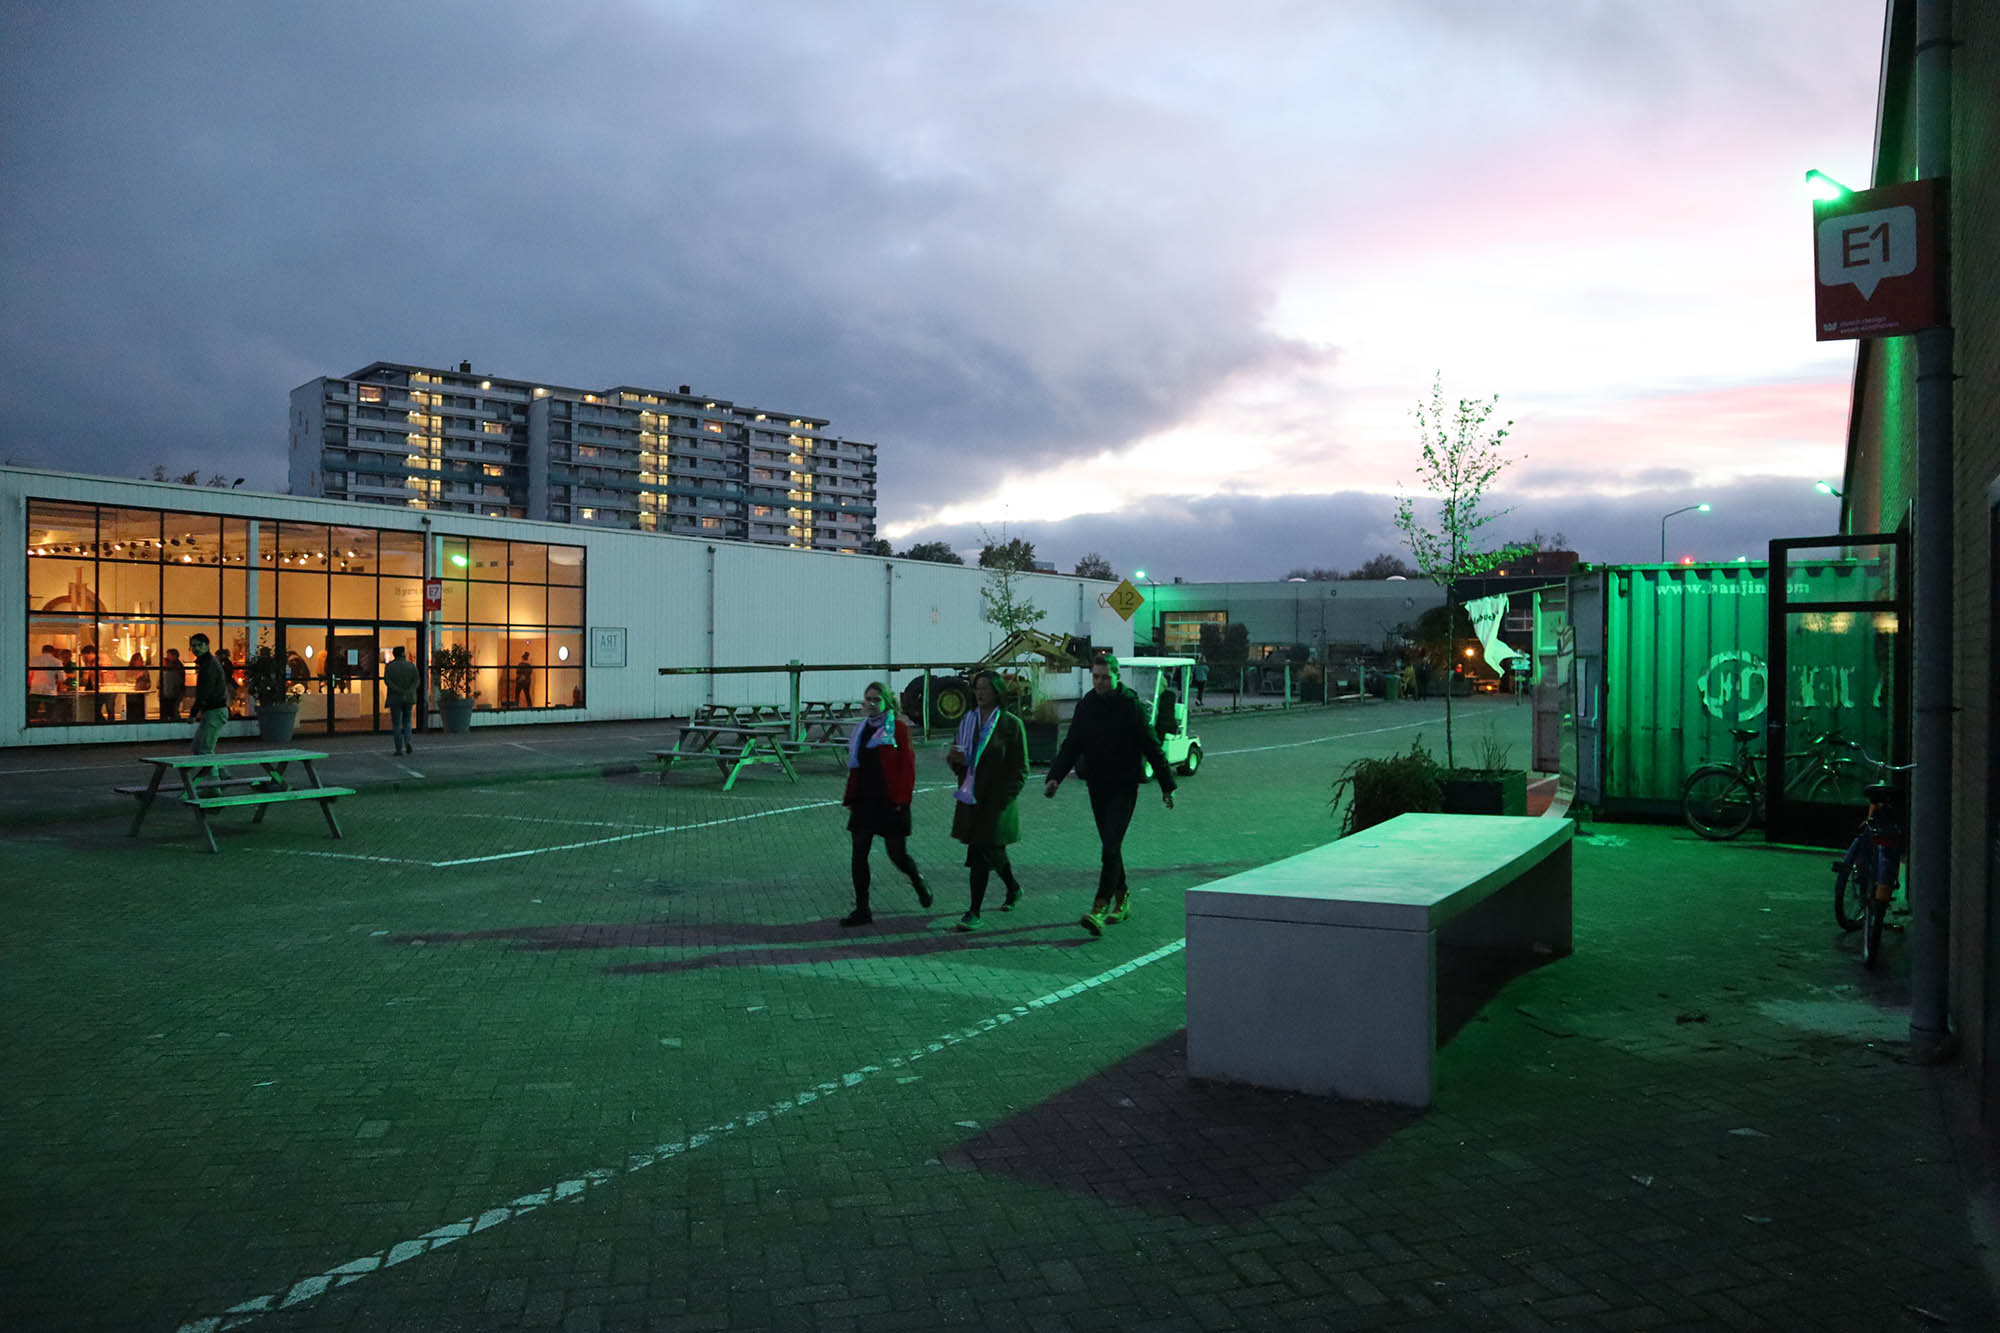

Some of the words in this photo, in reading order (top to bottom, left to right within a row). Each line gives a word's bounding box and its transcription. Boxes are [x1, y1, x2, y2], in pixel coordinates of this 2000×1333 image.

[1842, 222, 1890, 269] E1
[429, 586, 439, 597] E7
[1656, 581, 1810, 596] www.hanjinom
[1117, 591, 1134, 606] 12
